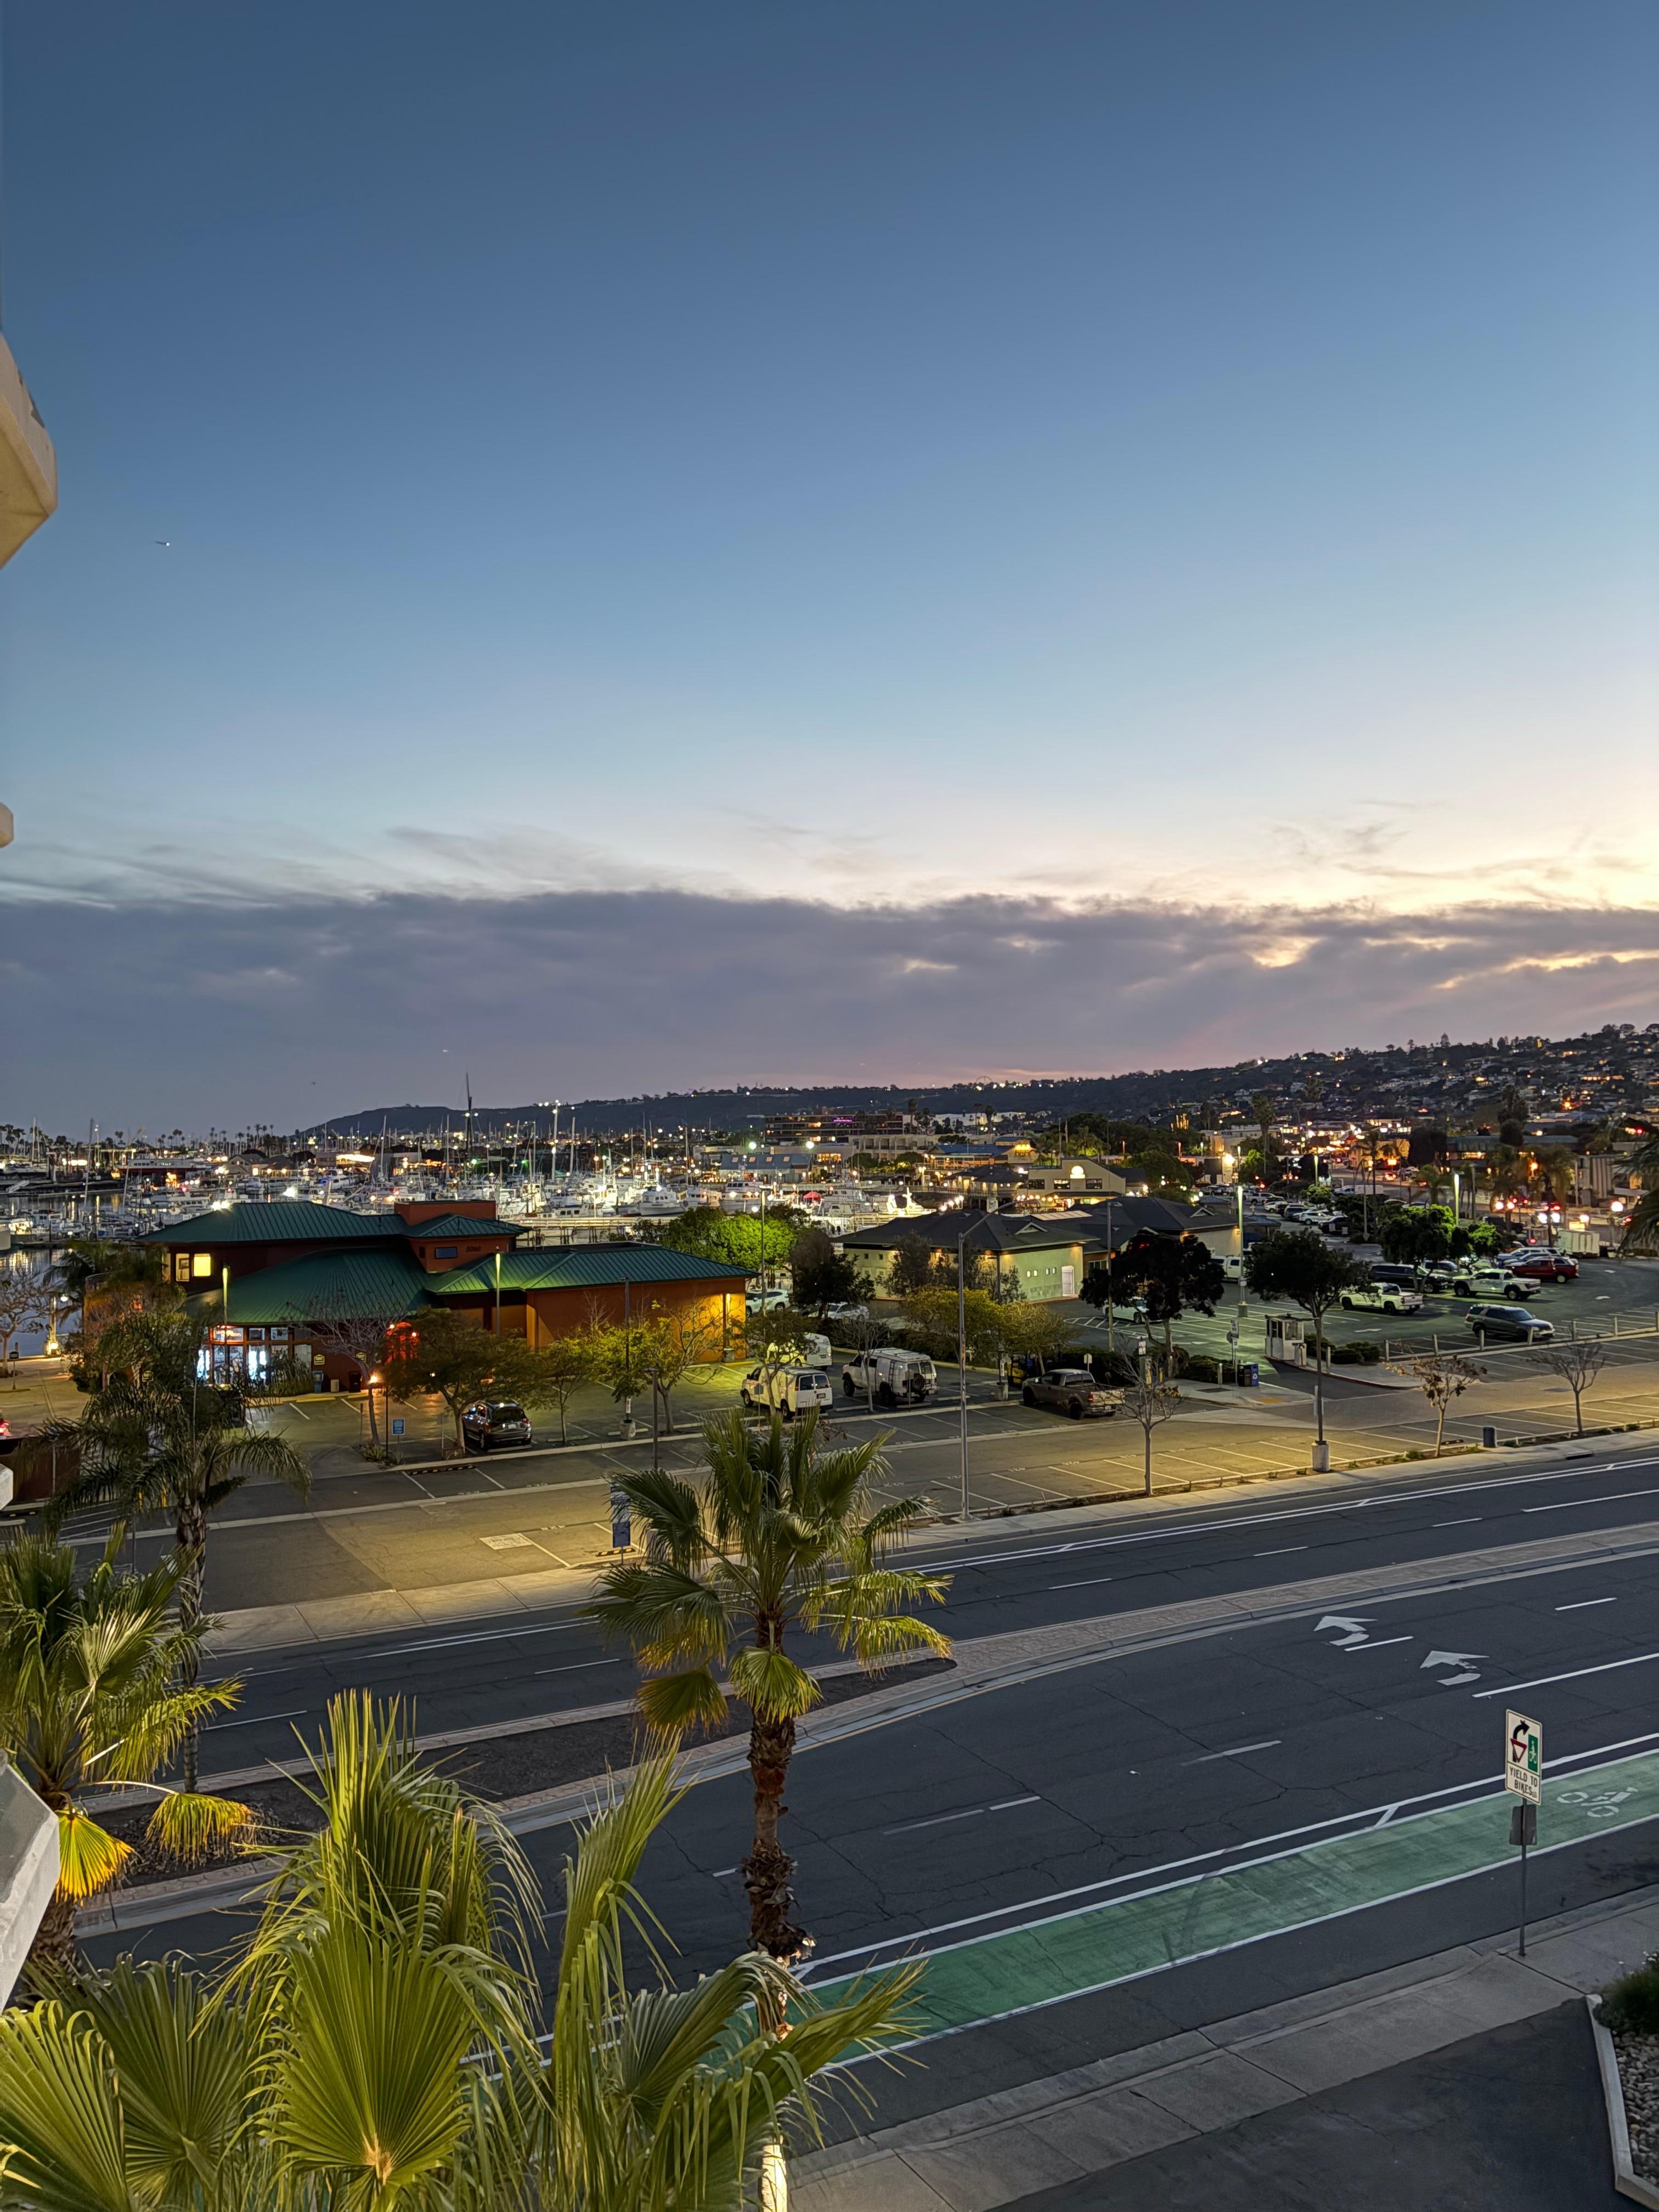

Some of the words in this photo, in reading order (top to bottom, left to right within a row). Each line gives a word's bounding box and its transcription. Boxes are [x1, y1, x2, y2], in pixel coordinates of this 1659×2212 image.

[1510, 1766, 1527, 1782] YIELD
[1531, 1775, 1538, 1787] TO
[1515, 1779, 1532, 1795] BIKES
